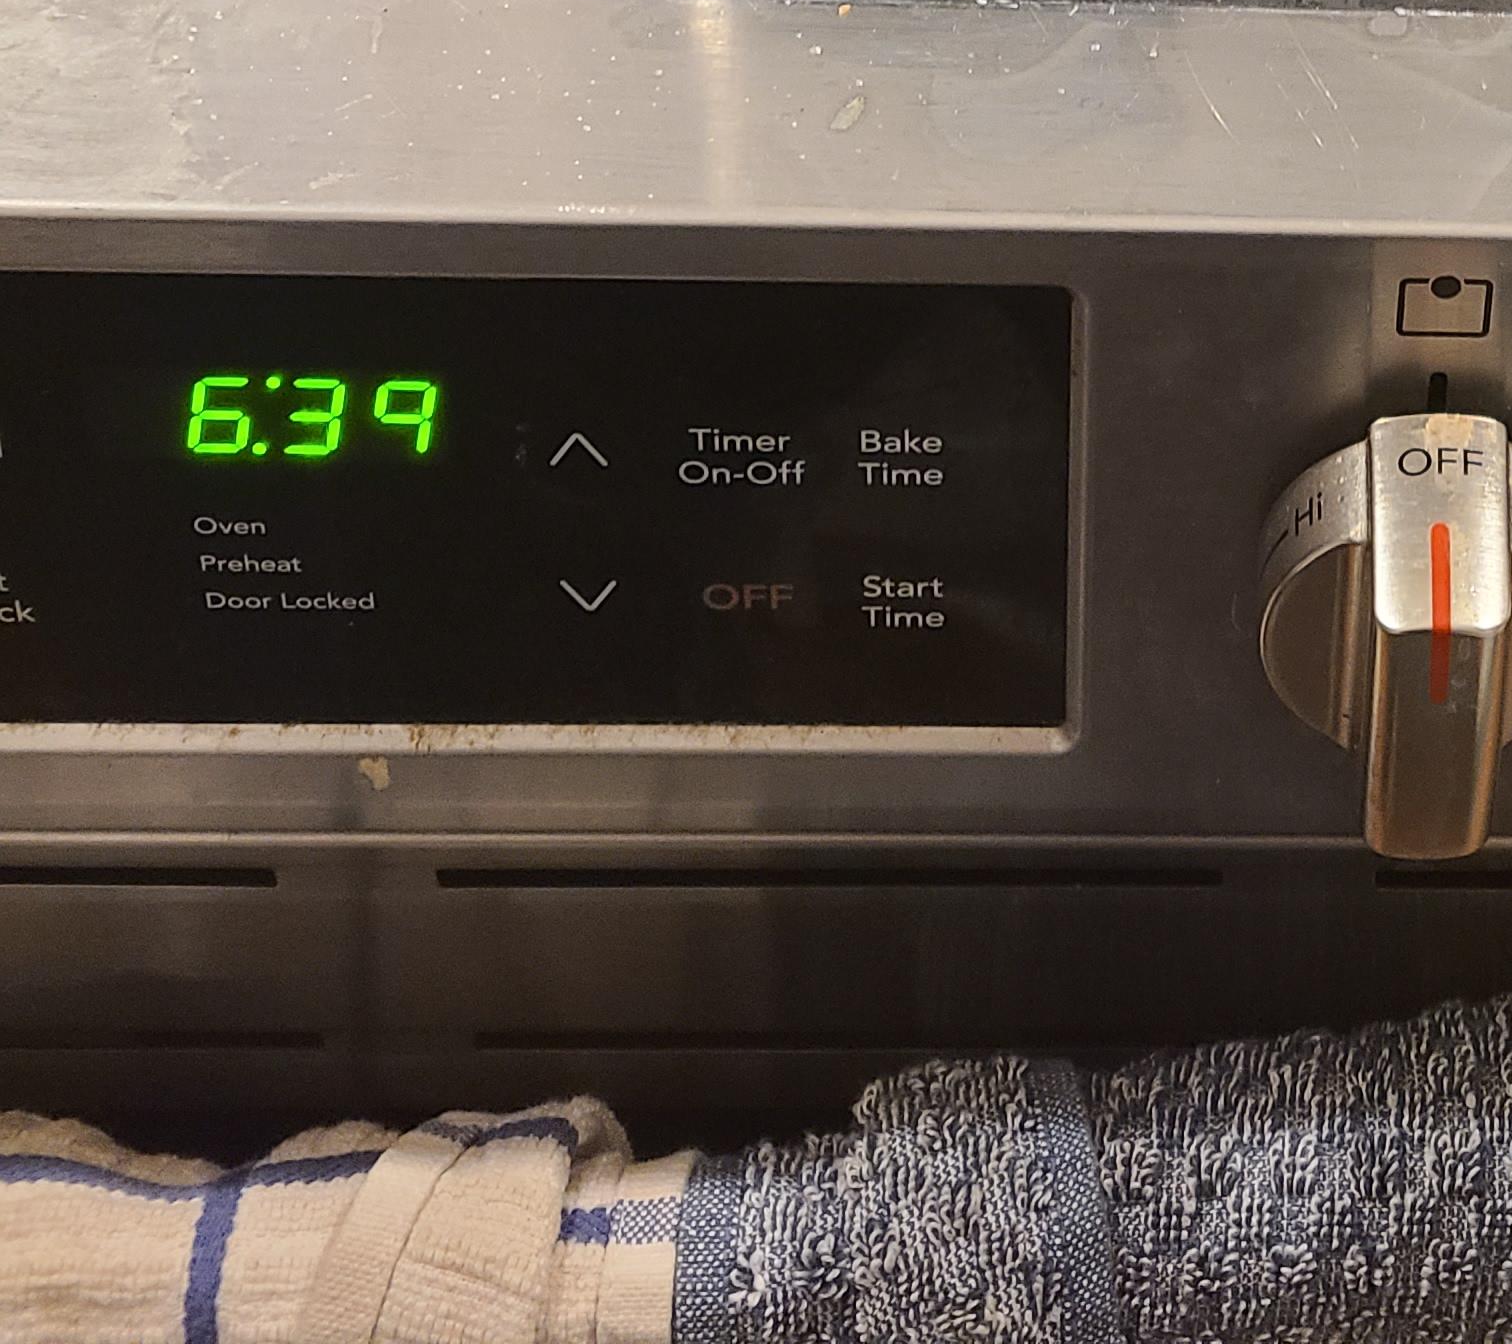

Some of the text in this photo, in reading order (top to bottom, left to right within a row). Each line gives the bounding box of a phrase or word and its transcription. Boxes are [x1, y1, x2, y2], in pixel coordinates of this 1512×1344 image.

[187, 376, 437, 455] 6:39
[688, 428, 791, 452] Timer
[860, 429, 942, 453] Bake
[678, 460, 805, 485] On-Off
[858, 462, 943, 486] Time
[1398, 448, 1484, 476] OFF
[194, 517, 266, 535] Oven
[1295, 492, 1322, 537] Hi
[200, 555, 302, 574] Preheat
[703, 583, 794, 610] OFF
[863, 575, 943, 599] Start
[0, 599, 36, 623] ck
[205, 592, 376, 611] Door Locked
[861, 606, 945, 628] Time
